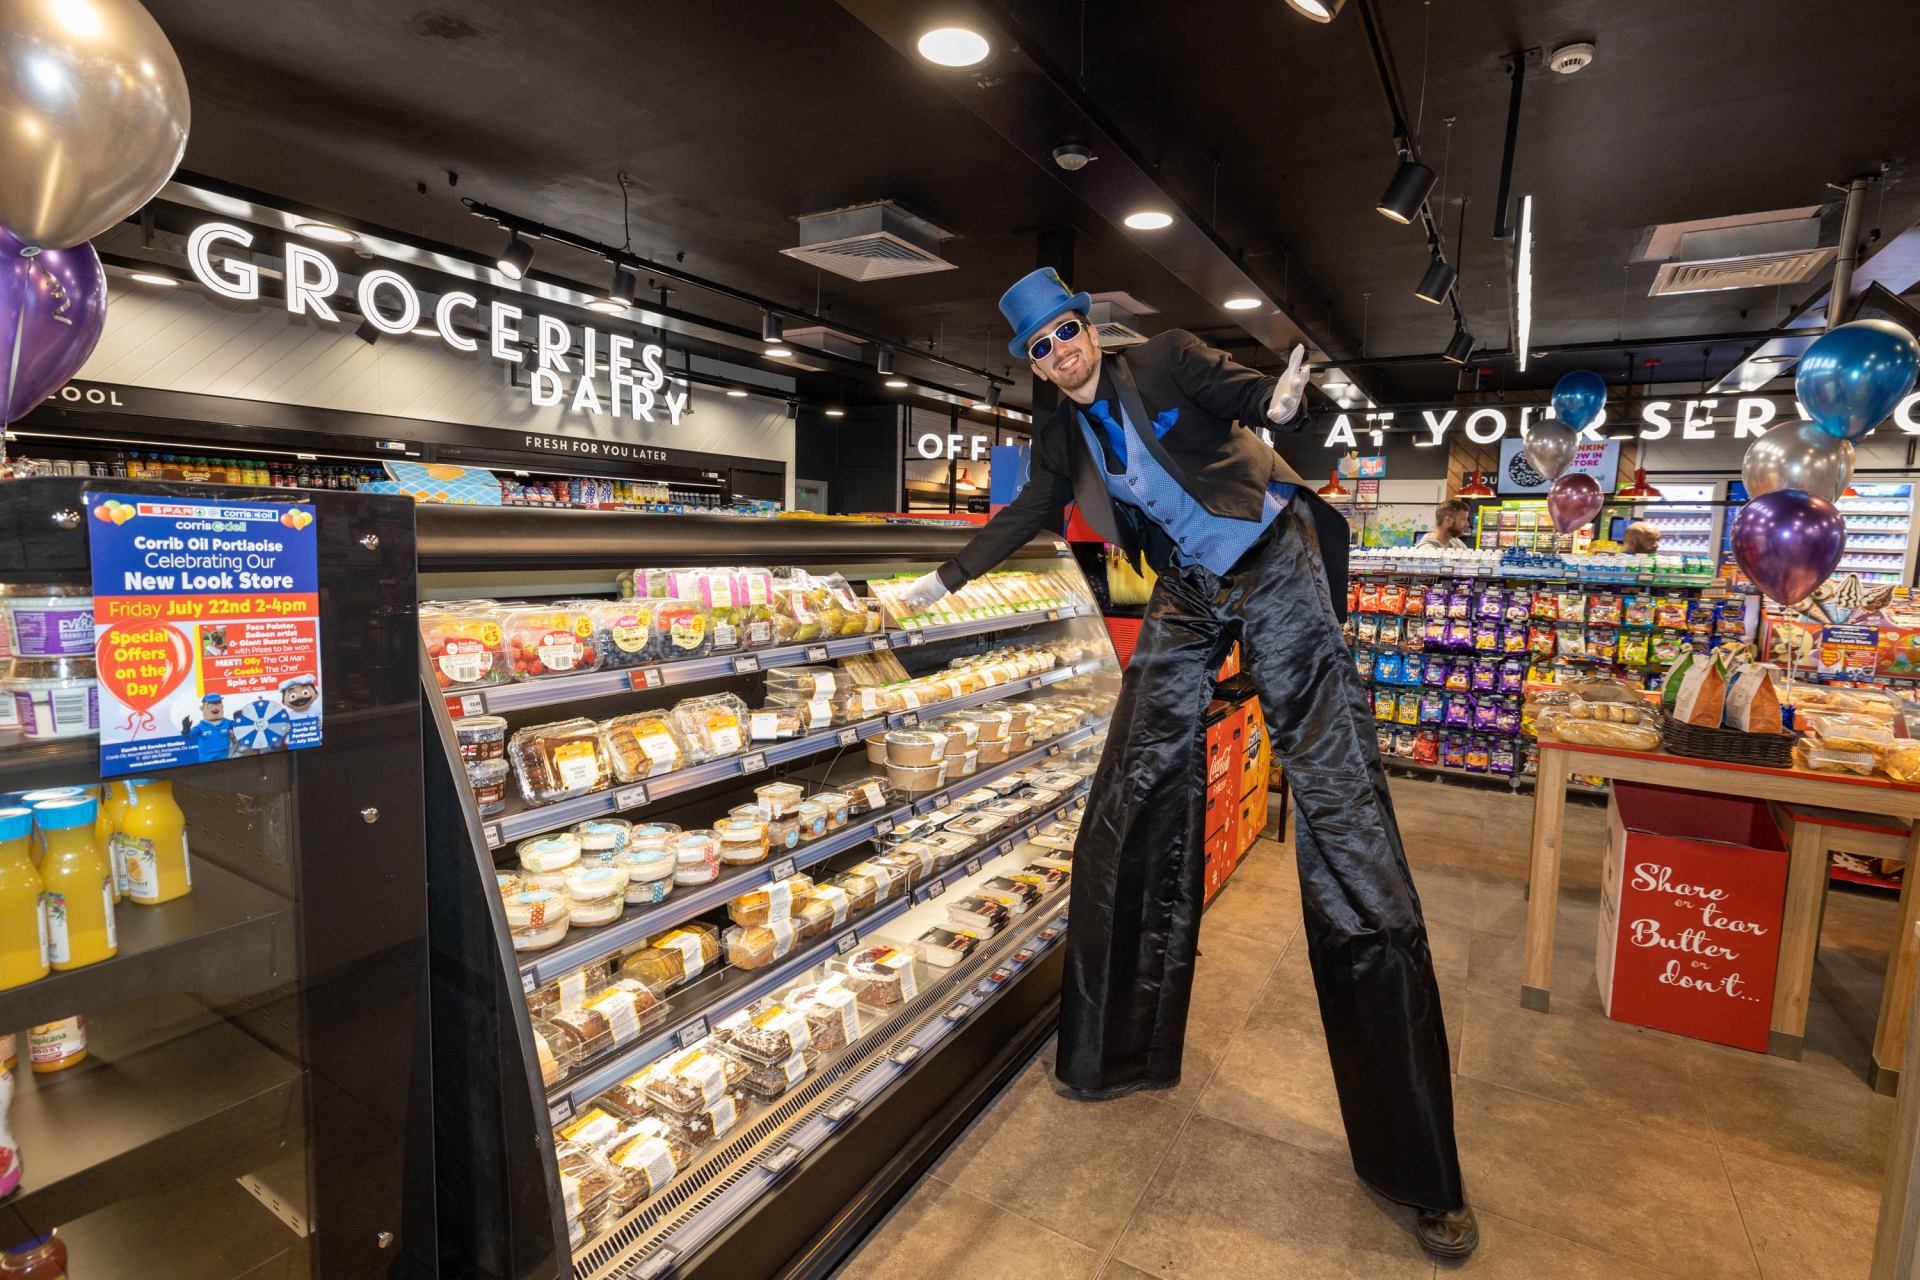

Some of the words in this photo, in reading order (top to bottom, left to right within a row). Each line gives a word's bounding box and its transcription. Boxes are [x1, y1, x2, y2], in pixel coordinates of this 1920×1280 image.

[187, 223, 664, 390] GROCERIES
[47, 386, 123, 406] OOL
[531, 367, 688, 426] DAIRY
[1324, 412, 1394, 447] AT
[526, 437, 568, 450] FRESH
[573, 442, 598, 454] FOR
[602, 445, 628, 457] YOU
[633, 449, 667, 461] LATER
[917, 433, 988, 461] OFF
[1362, 466, 1382, 474] CREAM
[152, 506, 193, 516] SPAR
[134, 536, 184, 550] Corrib
[188, 538, 208, 550] Oil
[212, 538, 283, 552] Portlaoise
[144, 552, 242, 572] Celebrating
[246, 554, 276, 568] Our
[124, 572, 174, 590] New
[182, 572, 234, 590] Look
[239, 572, 294, 588] Store
[110, 600, 162, 619] Friday
[166, 600, 204, 618] July
[208, 599, 250, 614] 22nd
[256, 598, 307, 614] 2-4pm
[59, 618, 94, 632] EVERE
[578, 624, 590, 634] €5
[110, 628, 168, 648] Special
[485, 631, 499, 641] €5
[114, 647, 166, 662] Offers
[215, 658, 242, 667] MEET!
[244, 657, 261, 666] Olly
[115, 669, 137, 679] on
[140, 664, 166, 678] the
[280, 664, 299, 672] Chef
[126, 683, 158, 698] Day
[226, 679, 247, 687] Spin
[460, 744, 478, 756] SE
[1631, 862, 1729, 900] Share
[1674, 900, 1694, 908] or
[1700, 902, 1768, 936] tear
[1630, 918, 1740, 960] Butter
[1691, 960, 1712, 970] or
